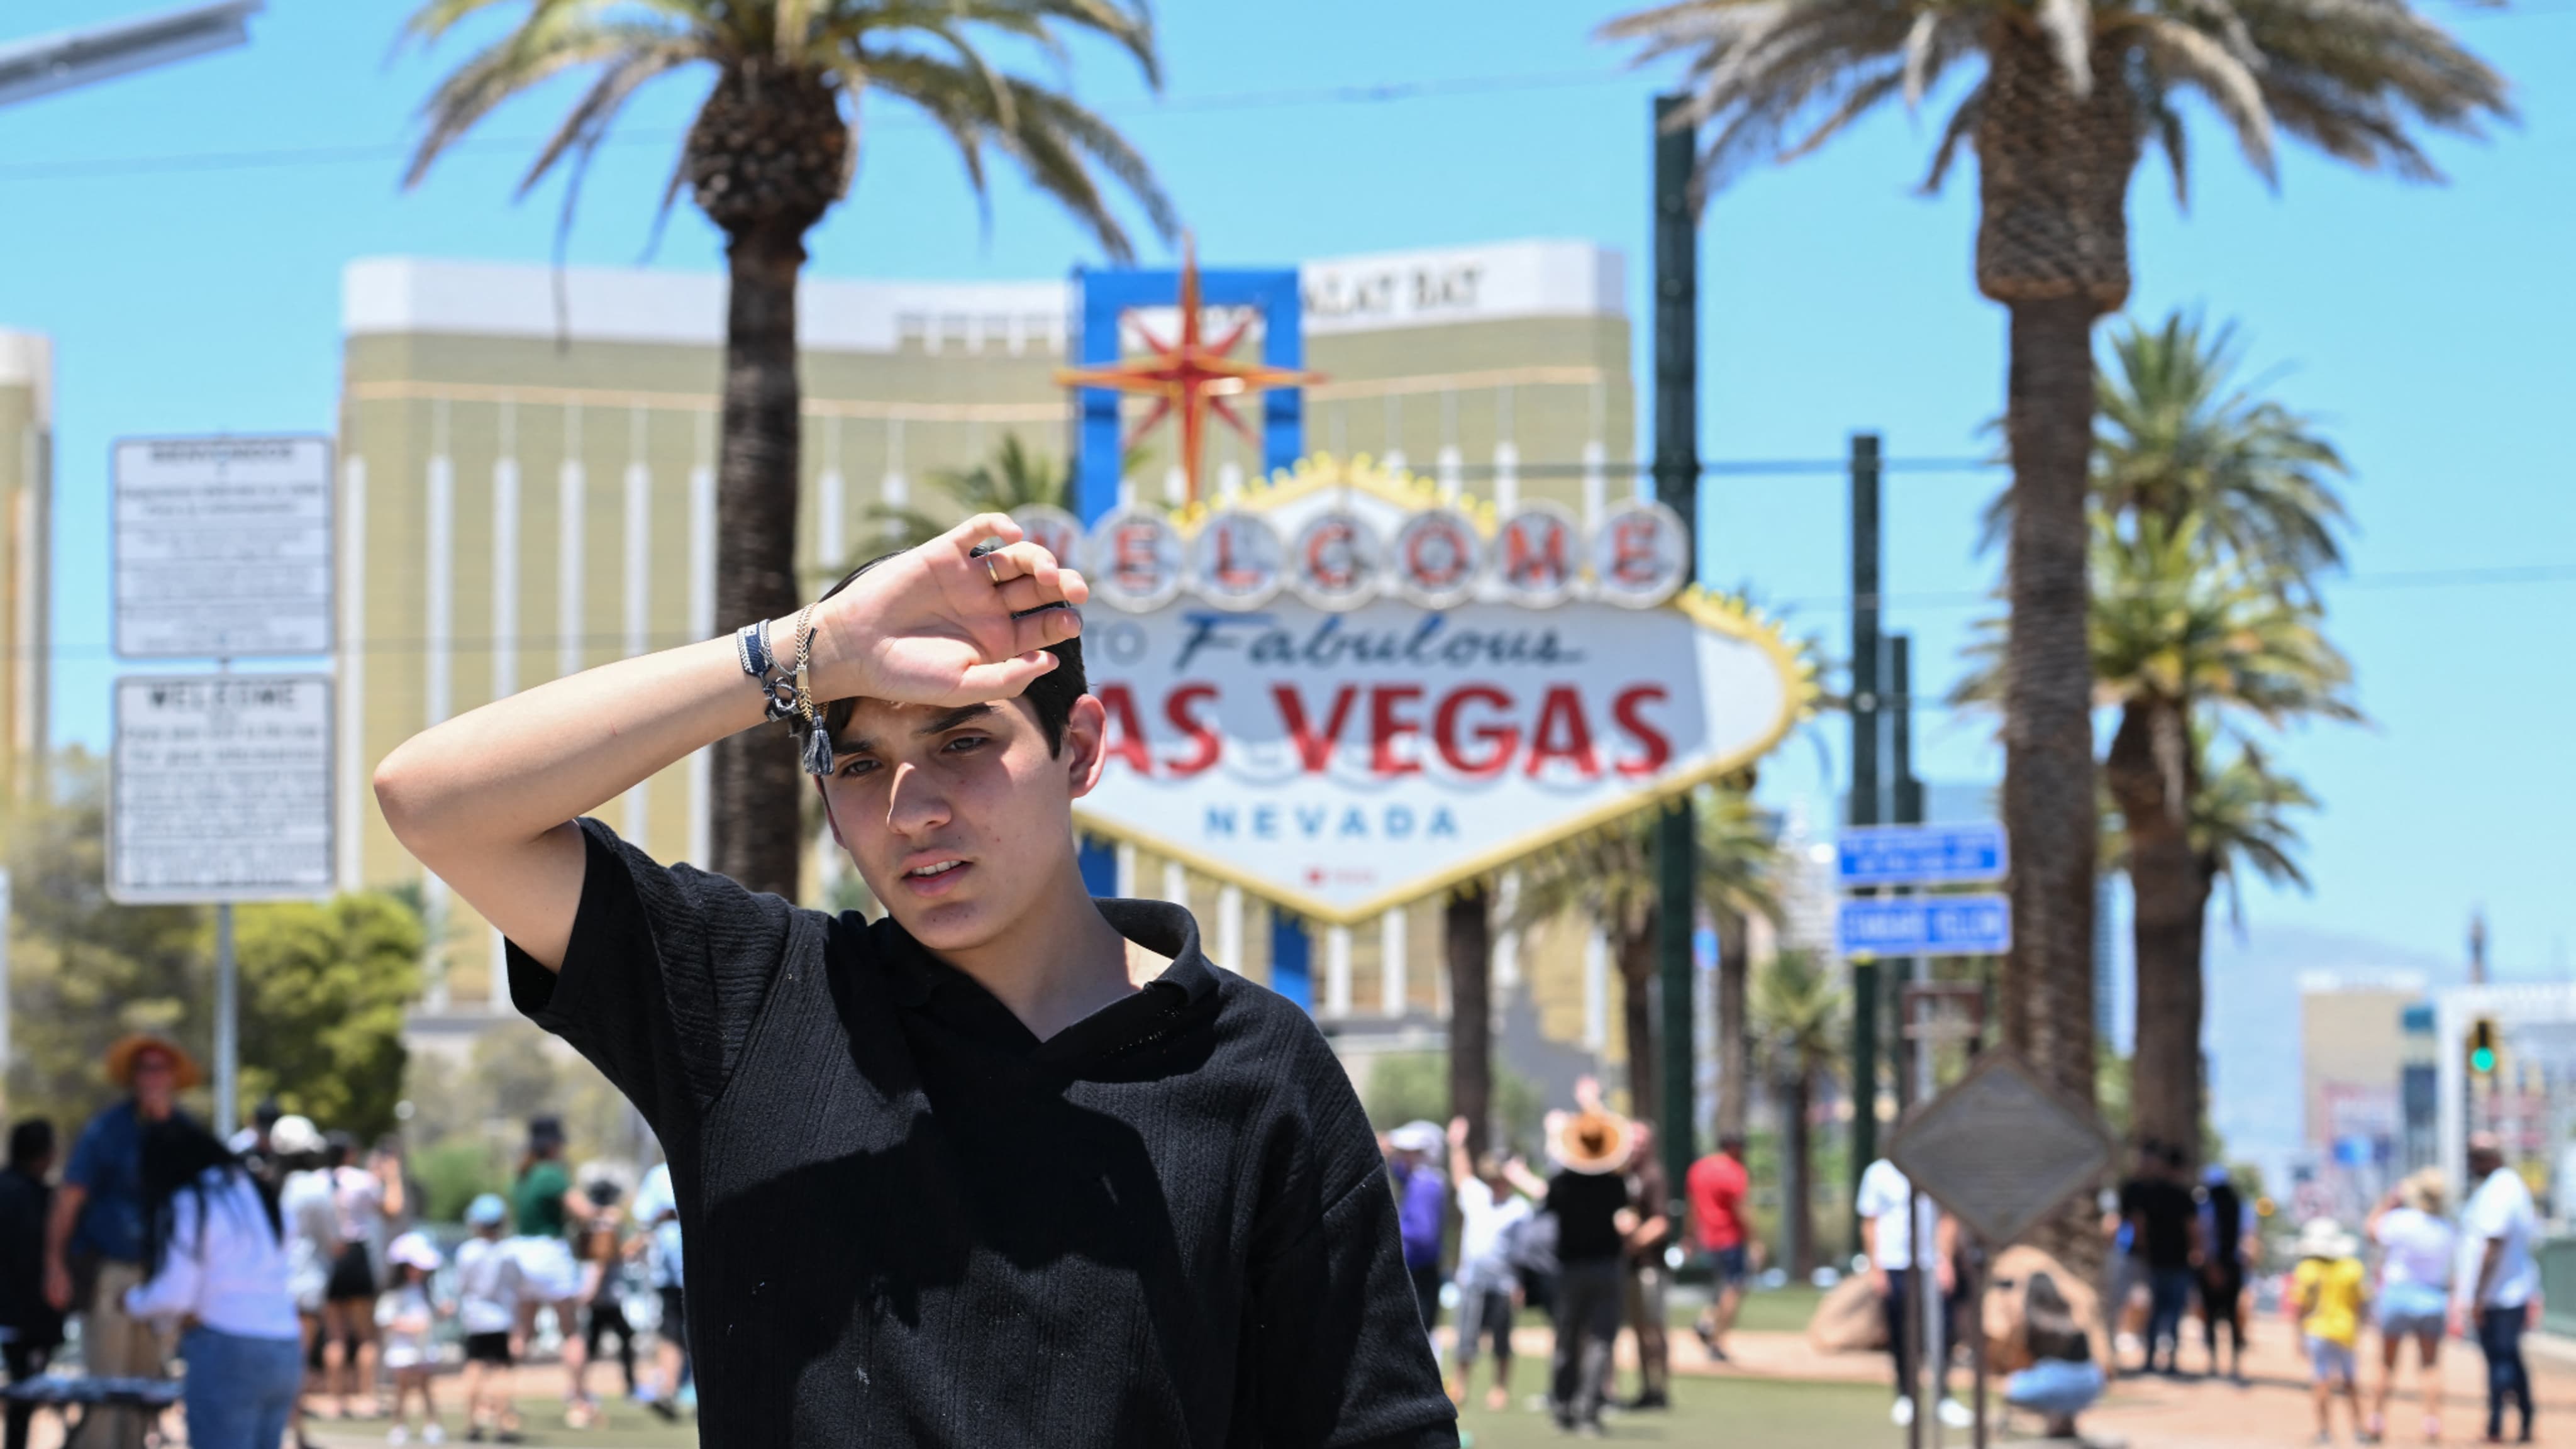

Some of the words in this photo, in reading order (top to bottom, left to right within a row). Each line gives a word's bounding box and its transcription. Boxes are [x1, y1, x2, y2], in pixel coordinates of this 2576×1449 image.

[1172, 611, 1586, 672] Fabulous
[1096, 681, 1223, 777] AS
[1270, 681, 1673, 778] VEGAS
[1204, 806, 1460, 840] NEVADA
